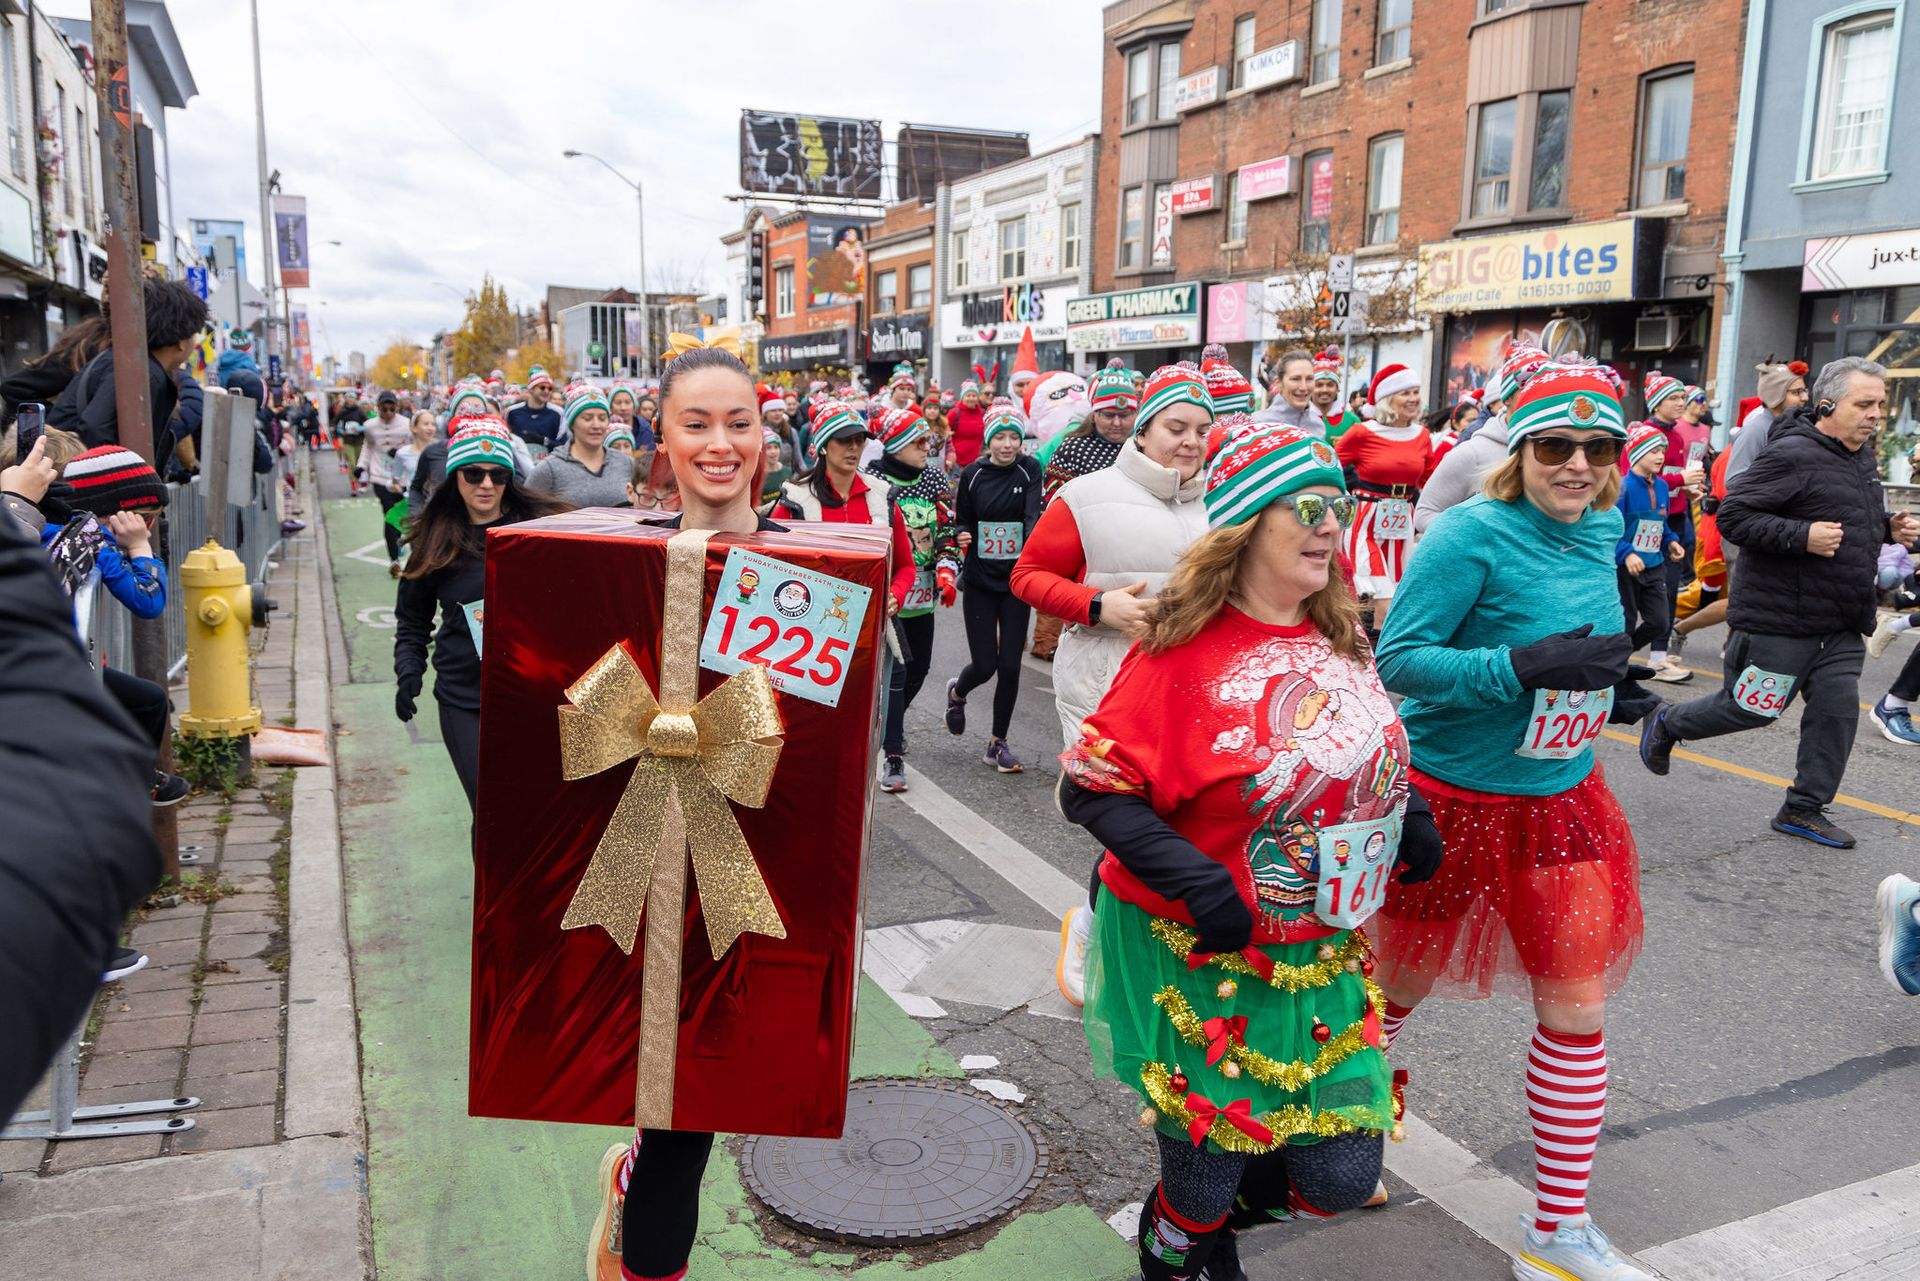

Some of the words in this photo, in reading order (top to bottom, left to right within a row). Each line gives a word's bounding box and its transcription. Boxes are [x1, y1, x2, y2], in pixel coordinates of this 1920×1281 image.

[1249, 47, 1290, 73] KIMKOR
[1068, 299, 1107, 323] GREEN
[1111, 286, 1192, 318] PHARMACY
[1381, 514, 1407, 529] 672
[983, 539, 1016, 555] 213
[743, 555, 771, 568] SUNDAY
[773, 565, 812, 580] NOVEMBER
[717, 605, 850, 687] 1225
[1737, 683, 1786, 711] 1654
[1531, 710, 1607, 749] 1204
